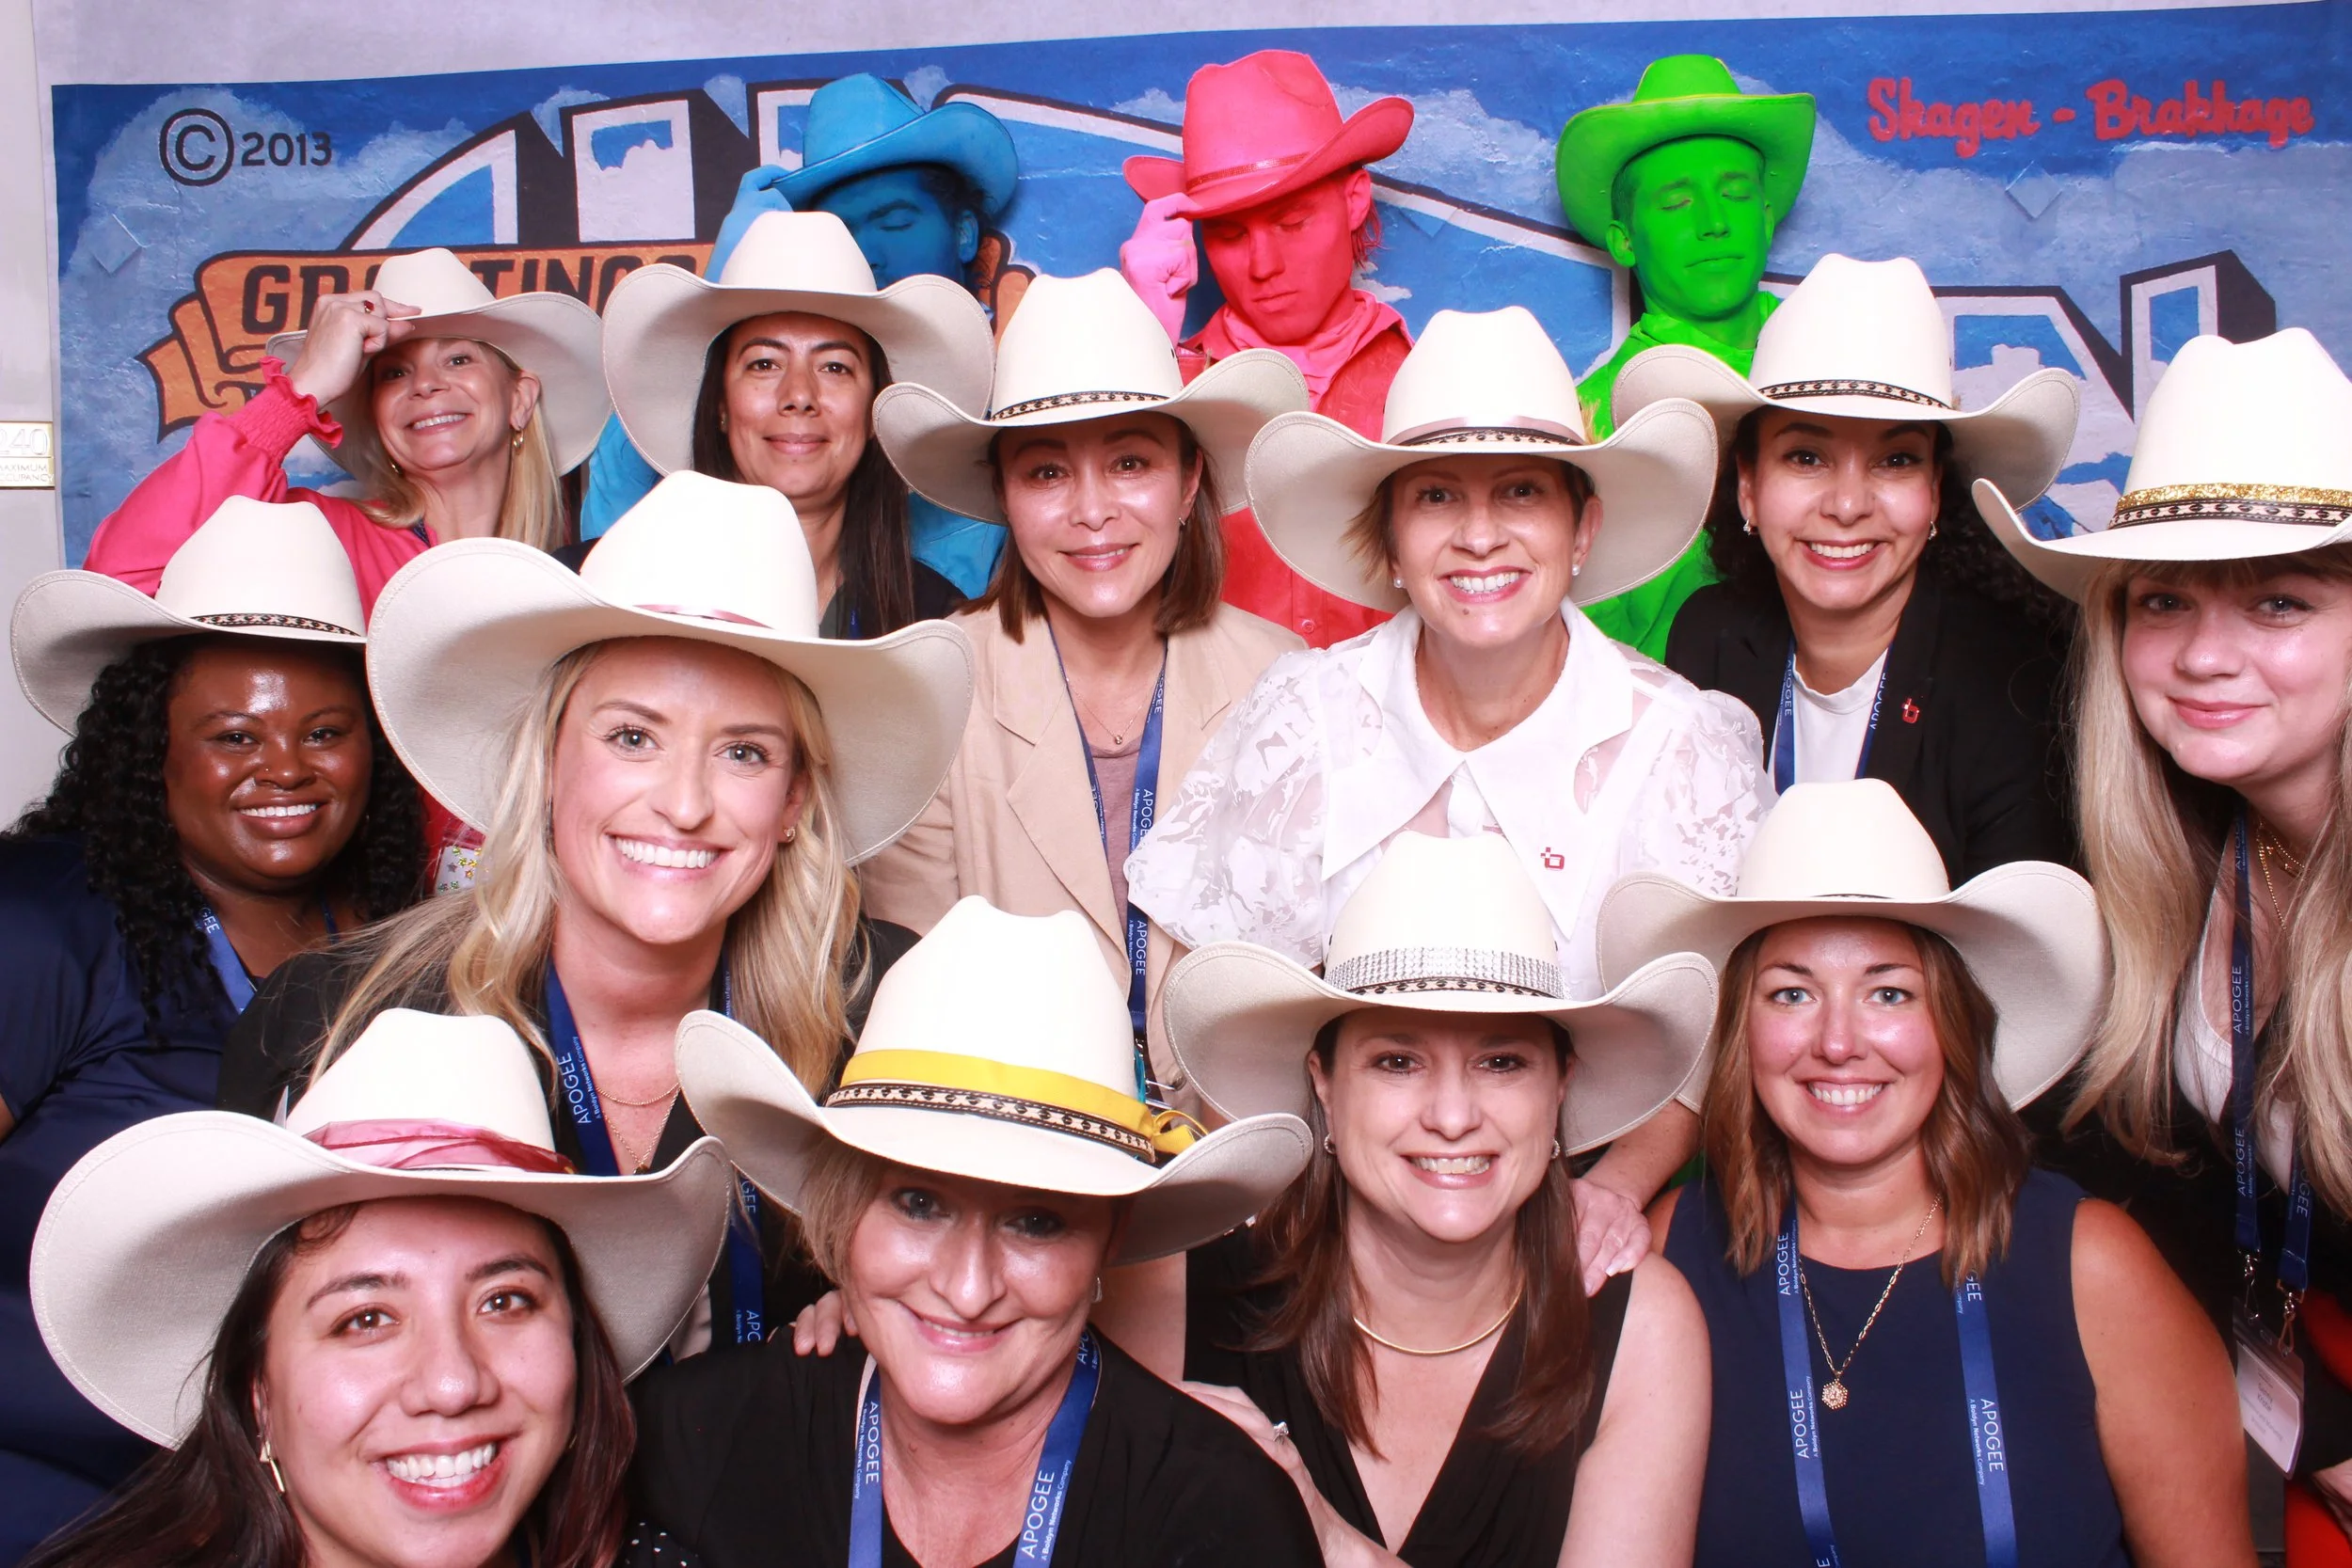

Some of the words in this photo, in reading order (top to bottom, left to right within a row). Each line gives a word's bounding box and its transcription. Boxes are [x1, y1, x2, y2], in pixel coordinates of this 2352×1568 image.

[1867, 76, 2041, 158] Skagen
[2085, 79, 2314, 149] Brakhage
[1139, 788, 1154, 839] APOGE
[1136, 920, 1148, 975] APOGEE
[2232, 966, 2242, 1034] APOGEE
[557, 1052, 592, 1124] APOGEE
[580, 1063, 594, 1093] Networks
[2235, 1128, 2247, 1197] APOGEE
[1777, 1232, 1791, 1296] APOGEE
[866, 1401, 880, 1484] APOGEE
[1790, 1388, 1810, 1459] APOGEE
[1973, 1427, 1981, 1457] Networks
[1977, 1458, 1985, 1486] Company
[1980, 1398, 2004, 1472] APOGEE
[1021, 1470, 1055, 1559] APOGEE
[1041, 1527, 1054, 1554] Boldyn
[1048, 1490, 1063, 1526] Networks
[1057, 1459, 1073, 1490] Company
